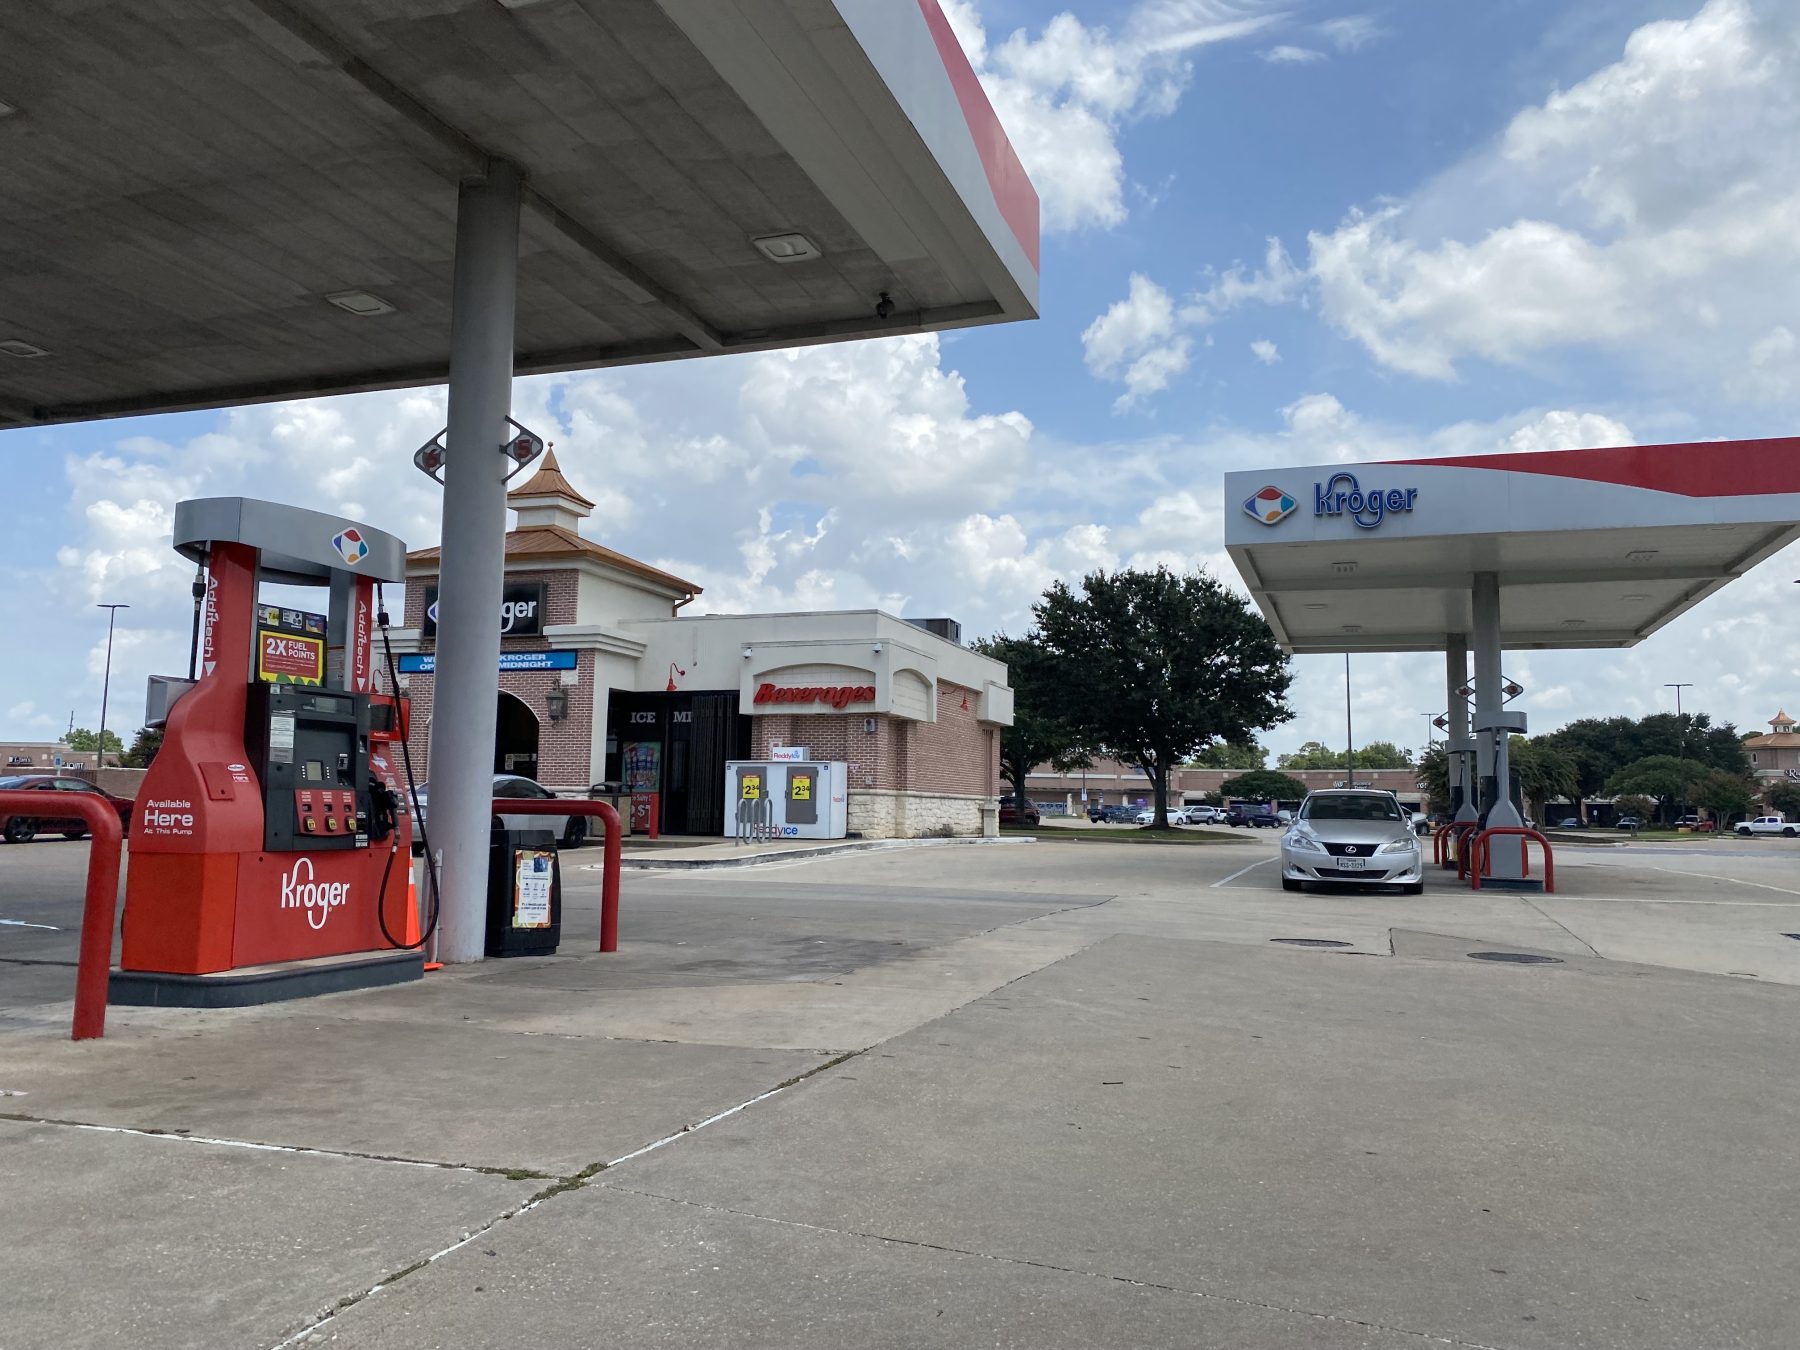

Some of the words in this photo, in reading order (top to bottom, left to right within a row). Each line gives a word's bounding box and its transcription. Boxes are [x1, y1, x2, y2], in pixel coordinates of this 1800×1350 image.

[1314, 472, 1417, 528] Kroger
[204, 575, 219, 658] Additech
[501, 601, 536, 633] ger
[288, 640, 308, 651] FUEL
[357, 600, 367, 674] Additech
[266, 637, 287, 656] 2X
[288, 649, 315, 660] POINTS
[499, 653, 546, 662] KROGER
[753, 683, 876, 710] Beverages
[629, 711, 656, 723] ICE
[147, 799, 191, 808] Available
[144, 809, 193, 826] Here
[172, 828, 193, 836] Pump
[281, 857, 350, 929] Kroger
